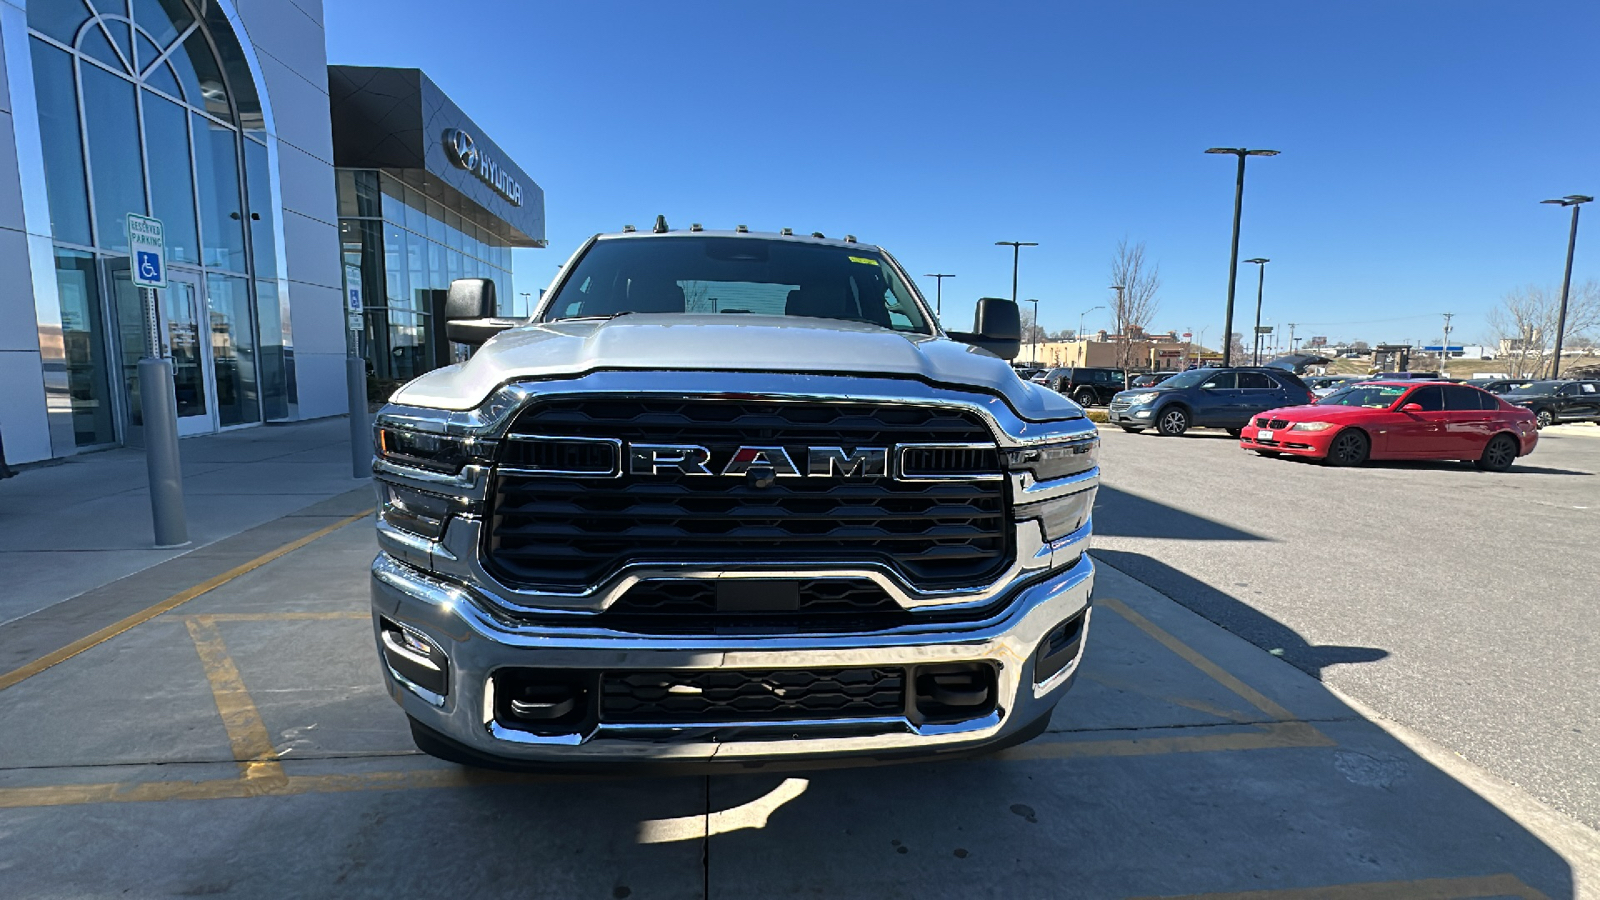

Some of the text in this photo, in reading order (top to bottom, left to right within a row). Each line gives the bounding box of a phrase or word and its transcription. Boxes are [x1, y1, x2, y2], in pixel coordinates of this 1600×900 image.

[480, 150, 523, 207] HYUNDAI
[131, 221, 160, 235] RESERVED
[131, 233, 162, 247] PARKING
[628, 442, 888, 478] RAM
